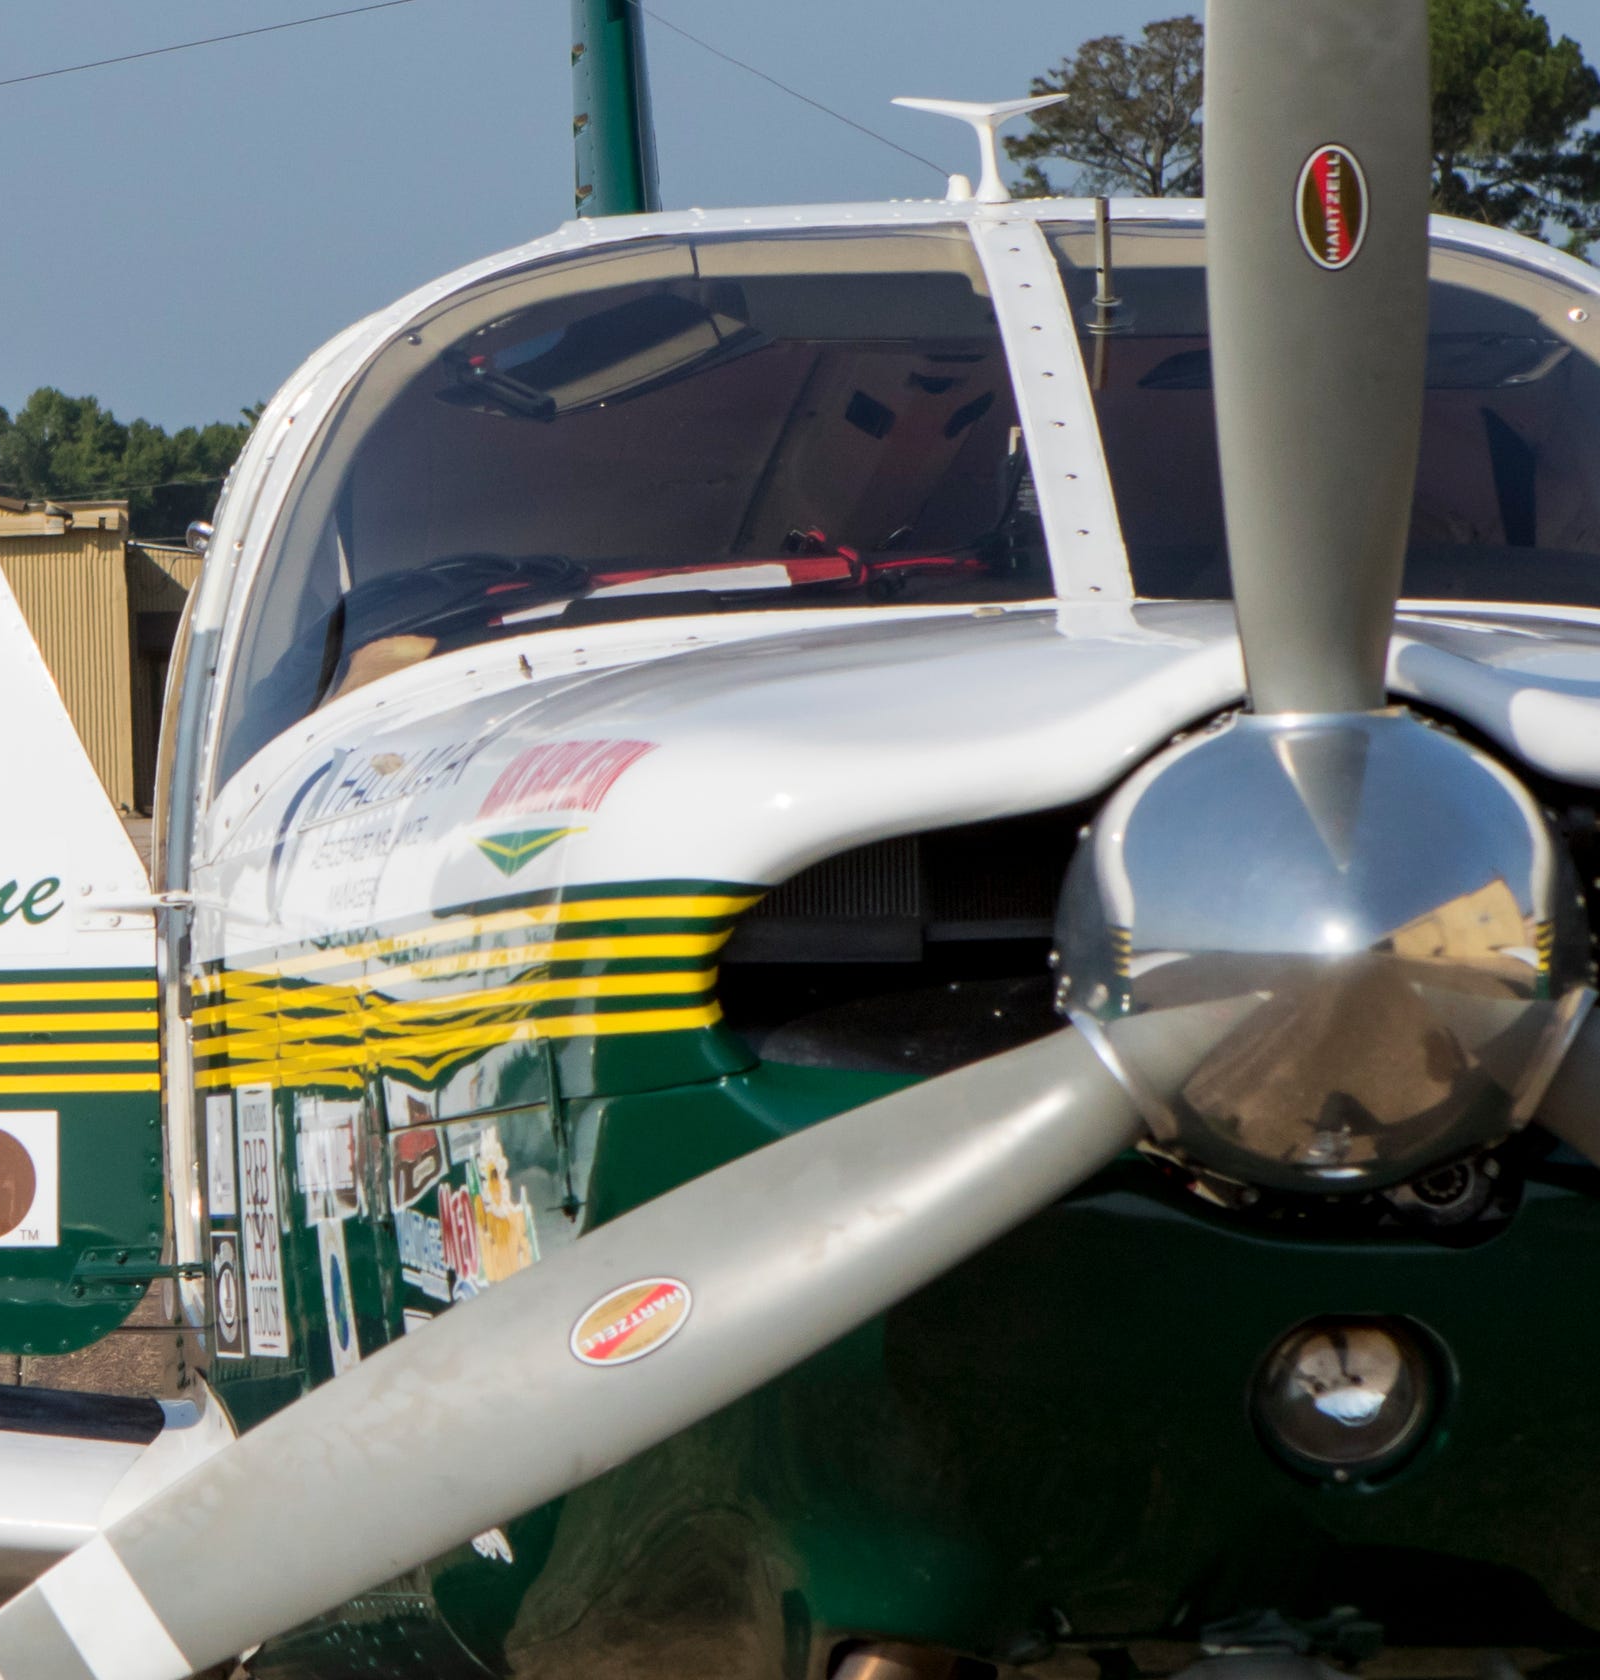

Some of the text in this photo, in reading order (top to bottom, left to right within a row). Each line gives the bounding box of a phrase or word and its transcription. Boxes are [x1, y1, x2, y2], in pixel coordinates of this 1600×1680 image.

[1325, 153, 1341, 261] HARTZELL
[20, 1230, 39, 1241] TM
[582, 1288, 684, 1351] HARTZELL
